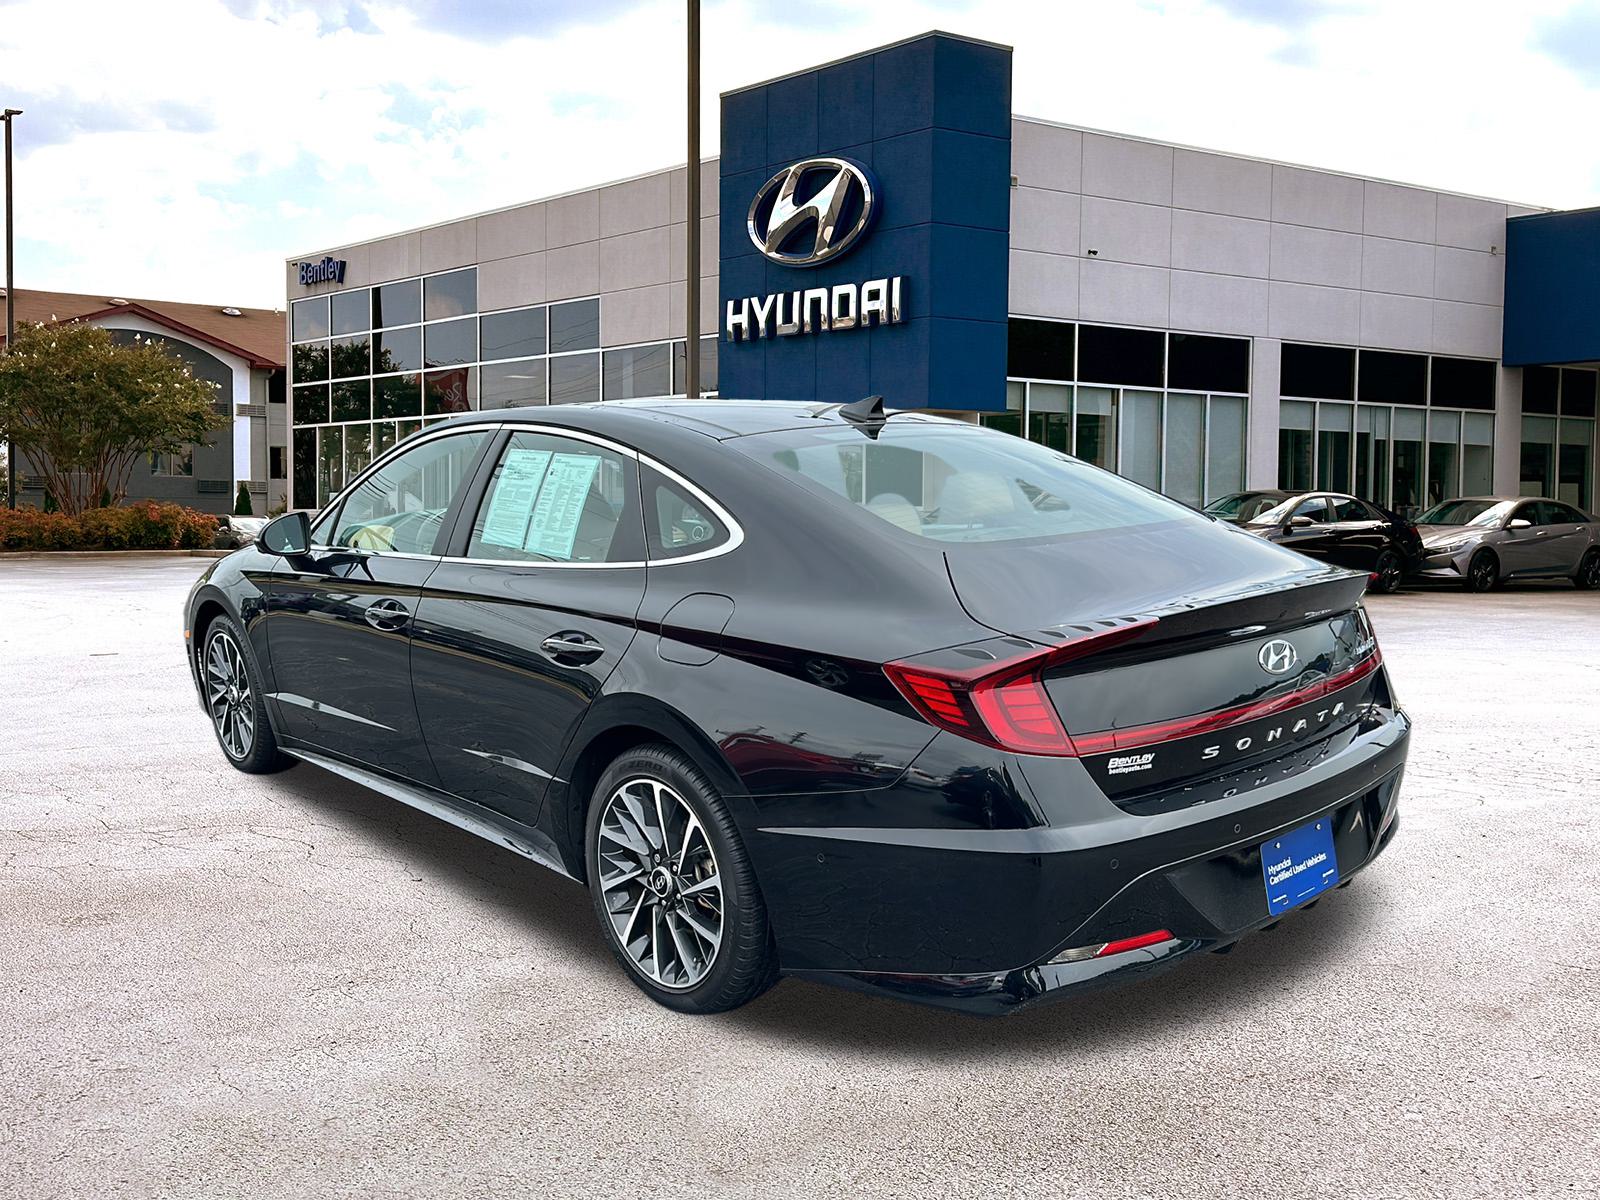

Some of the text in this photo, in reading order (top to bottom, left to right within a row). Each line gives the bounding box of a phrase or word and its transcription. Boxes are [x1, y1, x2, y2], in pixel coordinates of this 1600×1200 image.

[300, 256, 344, 285] Bentley
[726, 276, 904, 342] HYUNDAI
[1201, 702, 1345, 760] SONATA
[1268, 857, 1291, 875] Hyundai
[1270, 853, 1327, 885] Certified Used Vehicles
